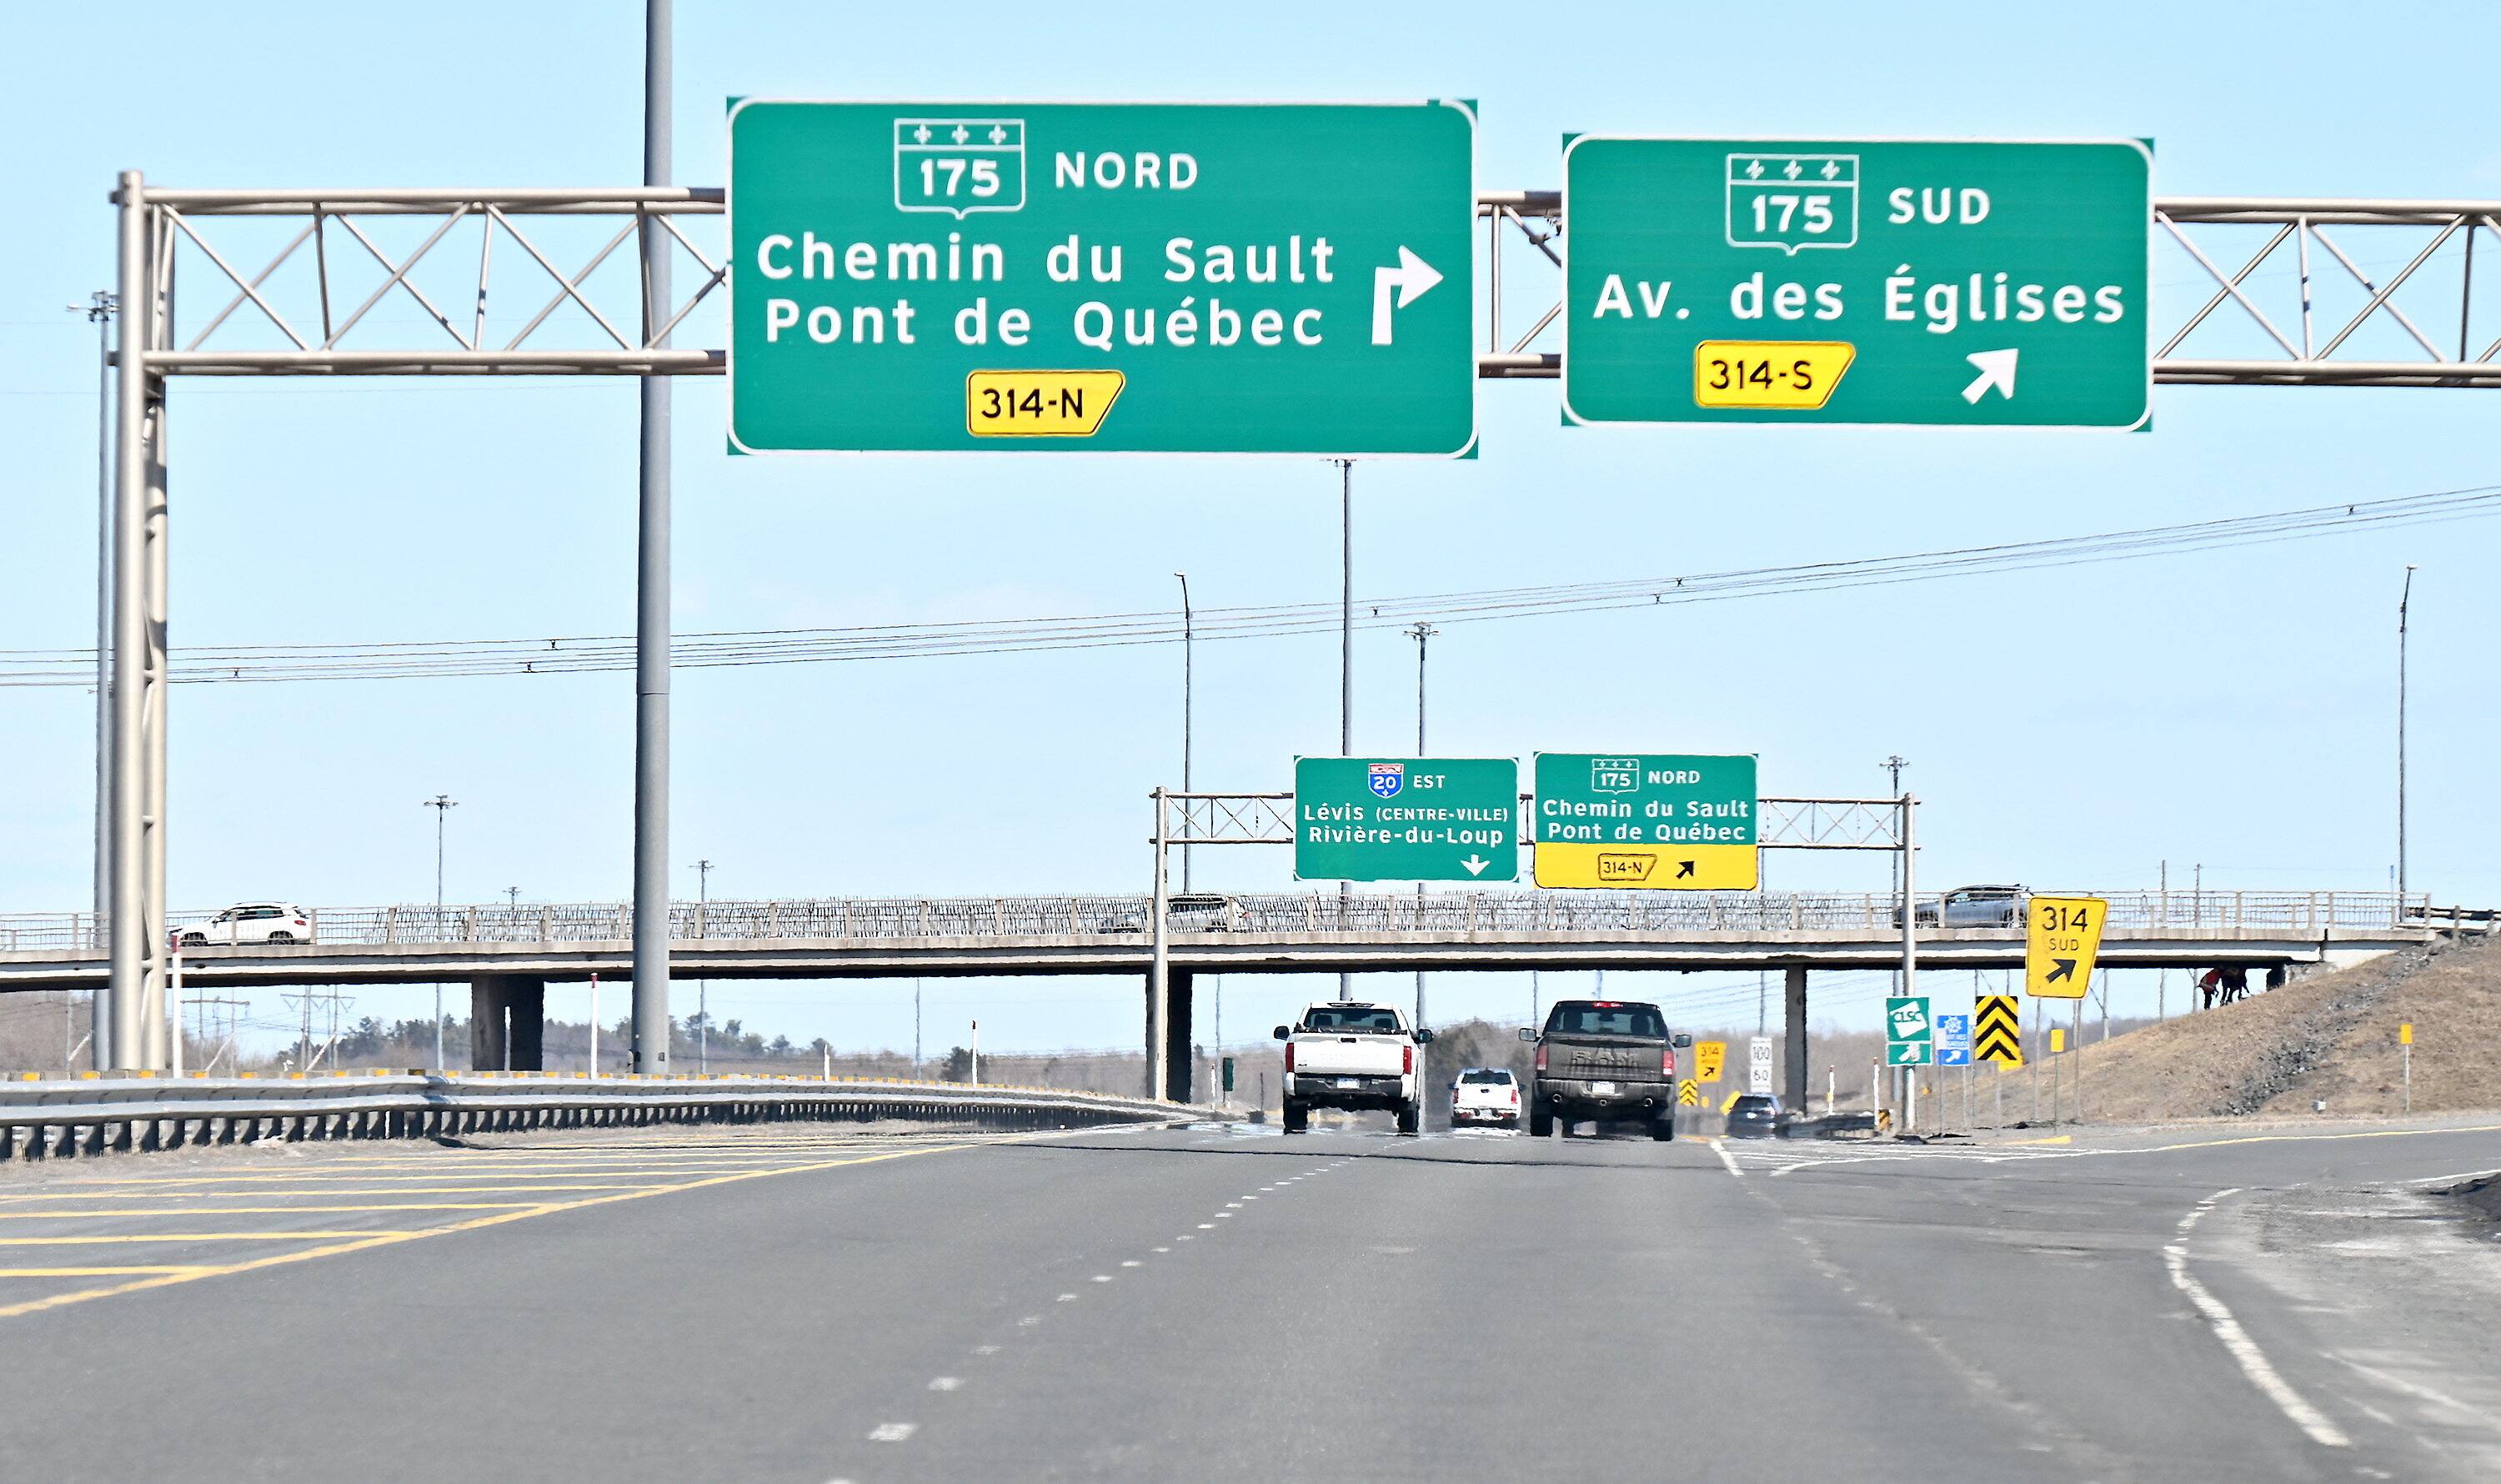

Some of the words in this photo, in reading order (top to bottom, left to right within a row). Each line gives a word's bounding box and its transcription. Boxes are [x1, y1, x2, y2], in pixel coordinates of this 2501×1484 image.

[920, 158, 1000, 198] 175
[1055, 152, 1198, 190] NORD
[1752, 194, 1833, 233] 175
[1888, 187, 1990, 224] SUD
[757, 231, 1004, 281] Chemin
[1046, 234, 1122, 283] du
[1164, 234, 1334, 283] Sault
[1593, 273, 1690, 319] Av.
[1730, 272, 1844, 321] des
[1885, 263, 2123, 334] Églises
[767, 298, 915, 344] Pont
[954, 297, 1031, 346] de
[1074, 296, 1322, 352] Québec
[1709, 359, 1812, 390] 314-S
[981, 388, 1083, 419] 314-N
[1373, 775, 1396, 790] 20
[1413, 775, 1446, 789] EST
[1601, 772, 1631, 787] 175
[1647, 770, 1701, 785] NORD
[1304, 802, 1364, 821] Lévis
[1376, 806, 1508, 822] (CENTRE-VILLE)
[1543, 799, 1631, 818] Chemin
[1645, 800, 1673, 818] du
[1687, 800, 1748, 818] Sault
[1309, 825, 1503, 848] Rivière-du-Loup
[1548, 822, 1602, 840] Pont
[1614, 823, 1642, 840] de
[1655, 821, 1746, 842] Québec
[1603, 861, 1642, 874] 314-N
[2042, 906, 2088, 932] 314
[2049, 938, 2079, 951] SUD
[1892, 1011, 1922, 1023] CLSC
[1752, 1045, 1770, 1060] 100
